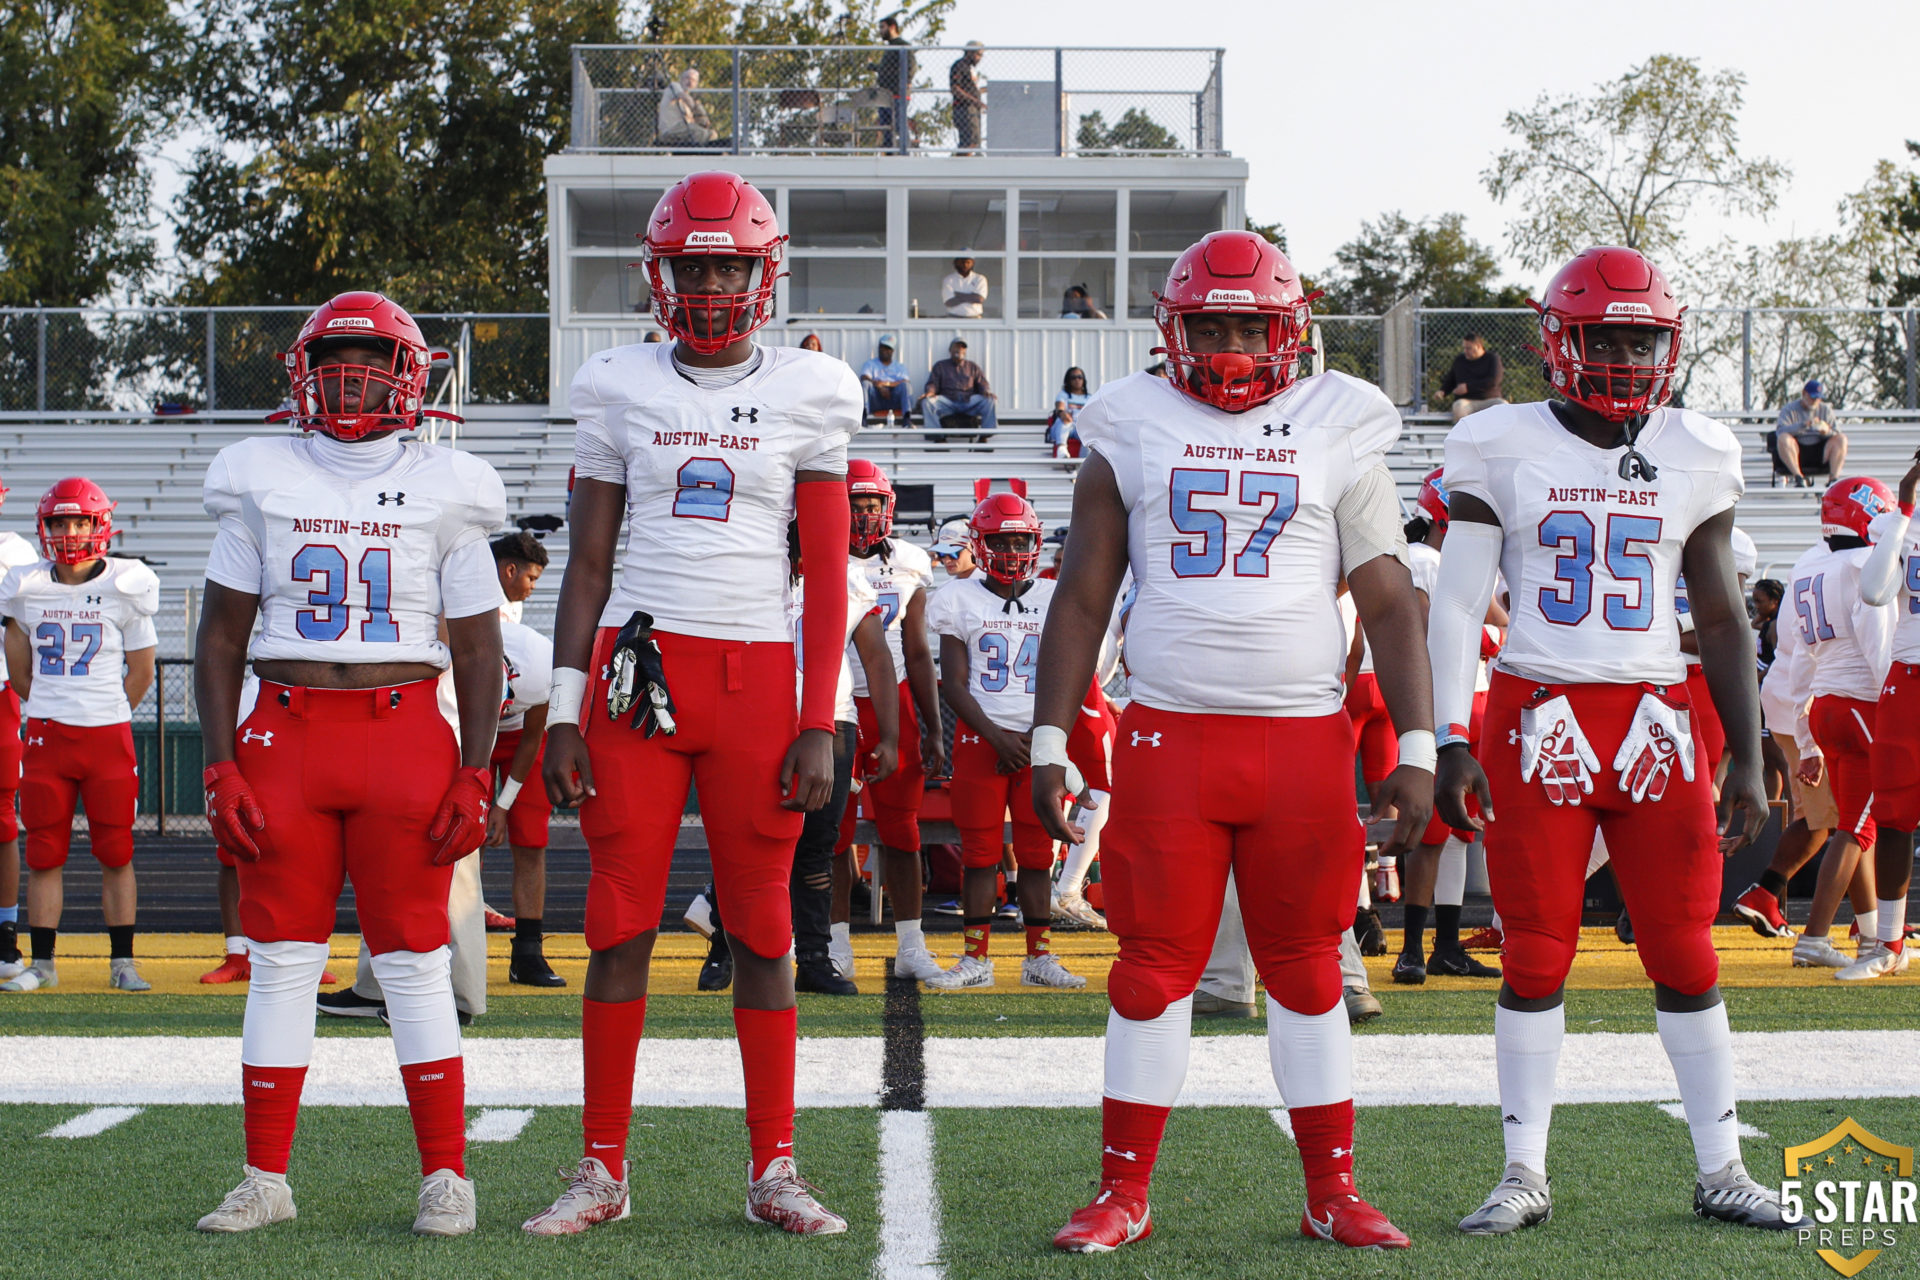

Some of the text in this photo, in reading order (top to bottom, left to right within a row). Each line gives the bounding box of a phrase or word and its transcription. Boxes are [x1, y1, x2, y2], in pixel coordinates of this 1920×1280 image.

[691, 235, 728, 243] Riddell
[1212, 293, 1249, 301] Riddell
[1612, 305, 1648, 313] Riddell
[332, 319, 368, 327] Riddell
[652, 431, 761, 451] AUSTIN-EAST
[1184, 444, 1298, 464] AUSTIN-EAST
[671, 457, 735, 523] 2
[1547, 487, 1659, 507] AUSTIN-EAST
[292, 517, 402, 539] AUSTIN-EAST
[1169, 467, 1300, 579] 57
[1537, 510, 1664, 632] 35
[291, 543, 401, 643] 31
[42, 609, 102, 620] AUSTIN-EAST
[1793, 573, 1837, 646] 51
[982, 620, 1040, 631] AUSTIN-EAST
[36, 622, 103, 676] 27
[978, 632, 1041, 695] 34
